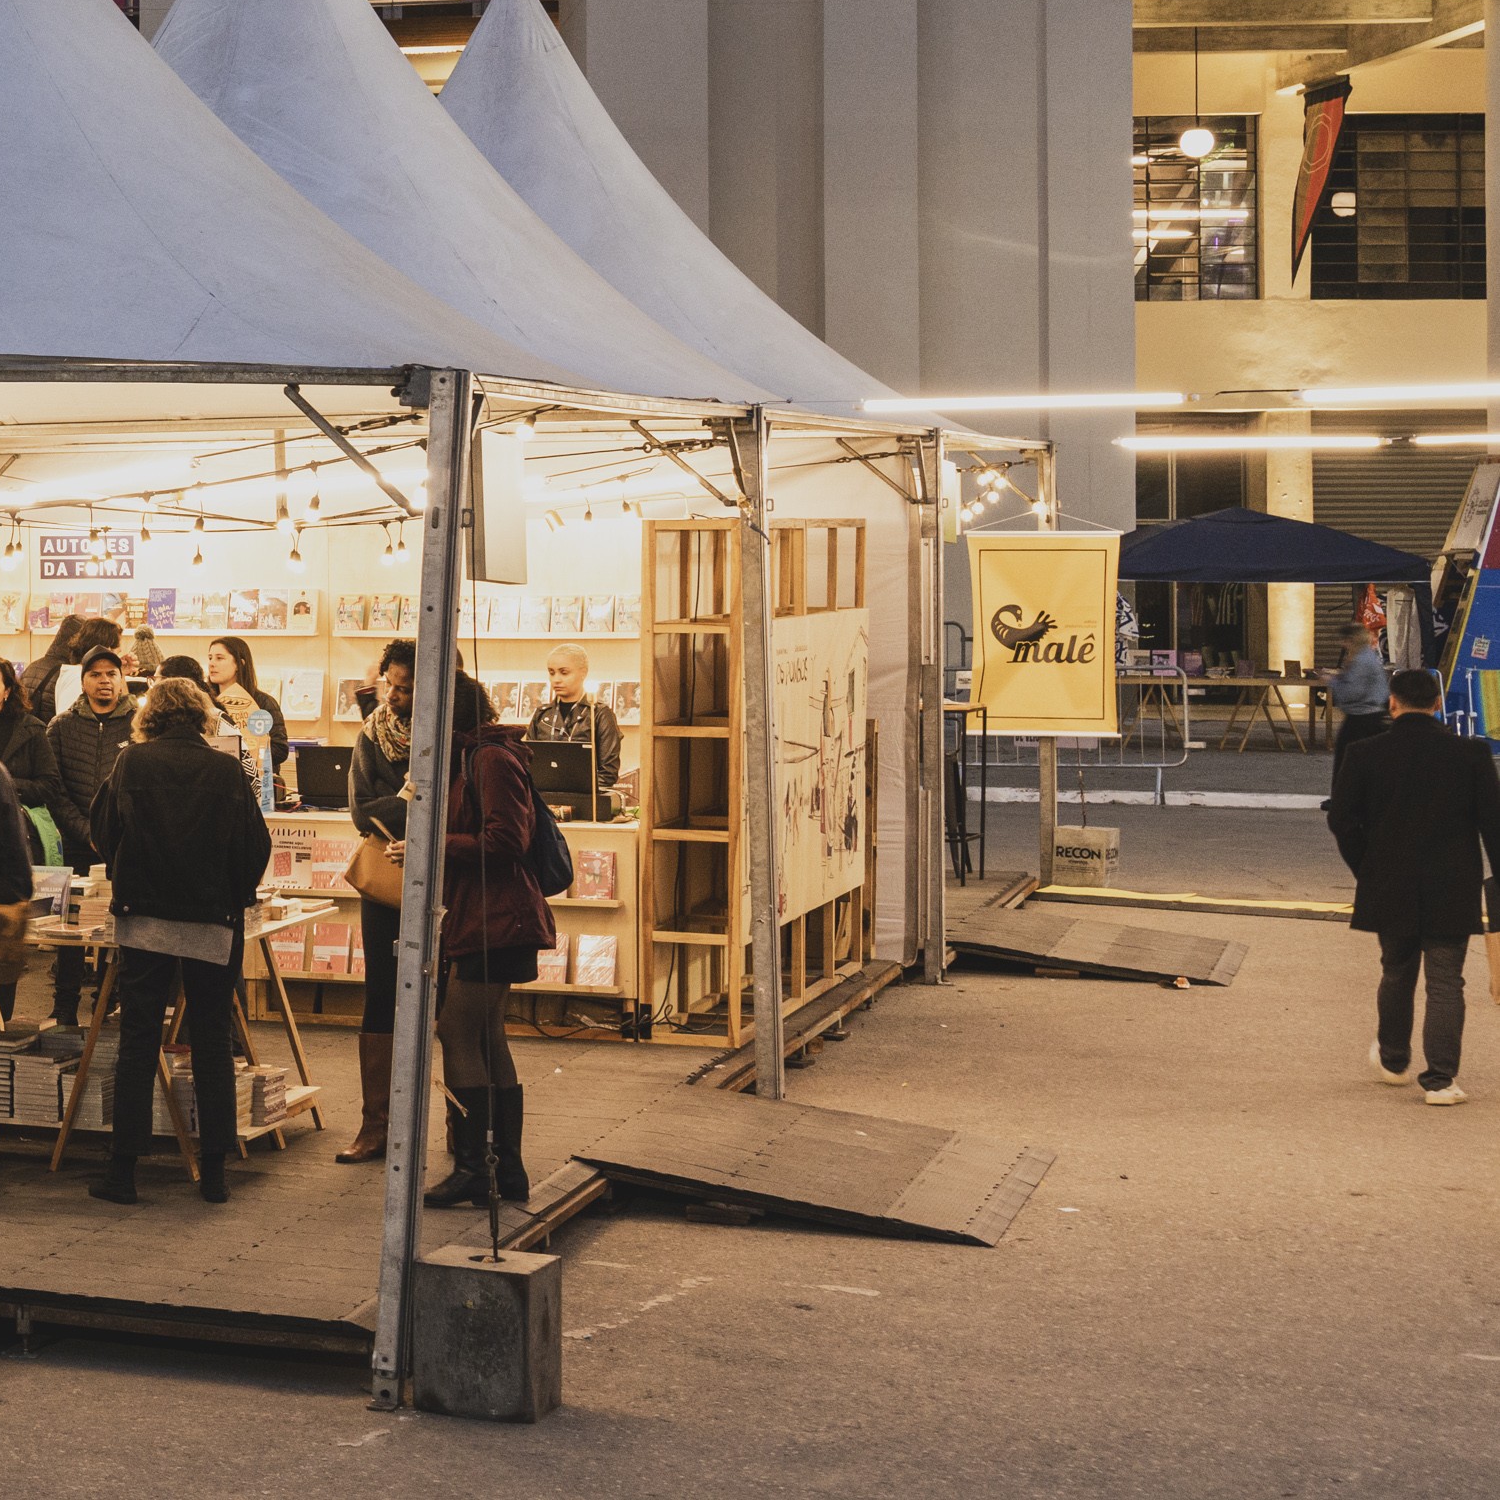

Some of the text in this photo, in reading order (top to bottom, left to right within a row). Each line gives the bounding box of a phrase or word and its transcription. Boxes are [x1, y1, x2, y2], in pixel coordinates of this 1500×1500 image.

[42, 538, 130, 553] AUTOES
[43, 561, 69, 576] DA
[1006, 632, 1097, 664] malê
[1055, 845, 1101, 860] RECON
